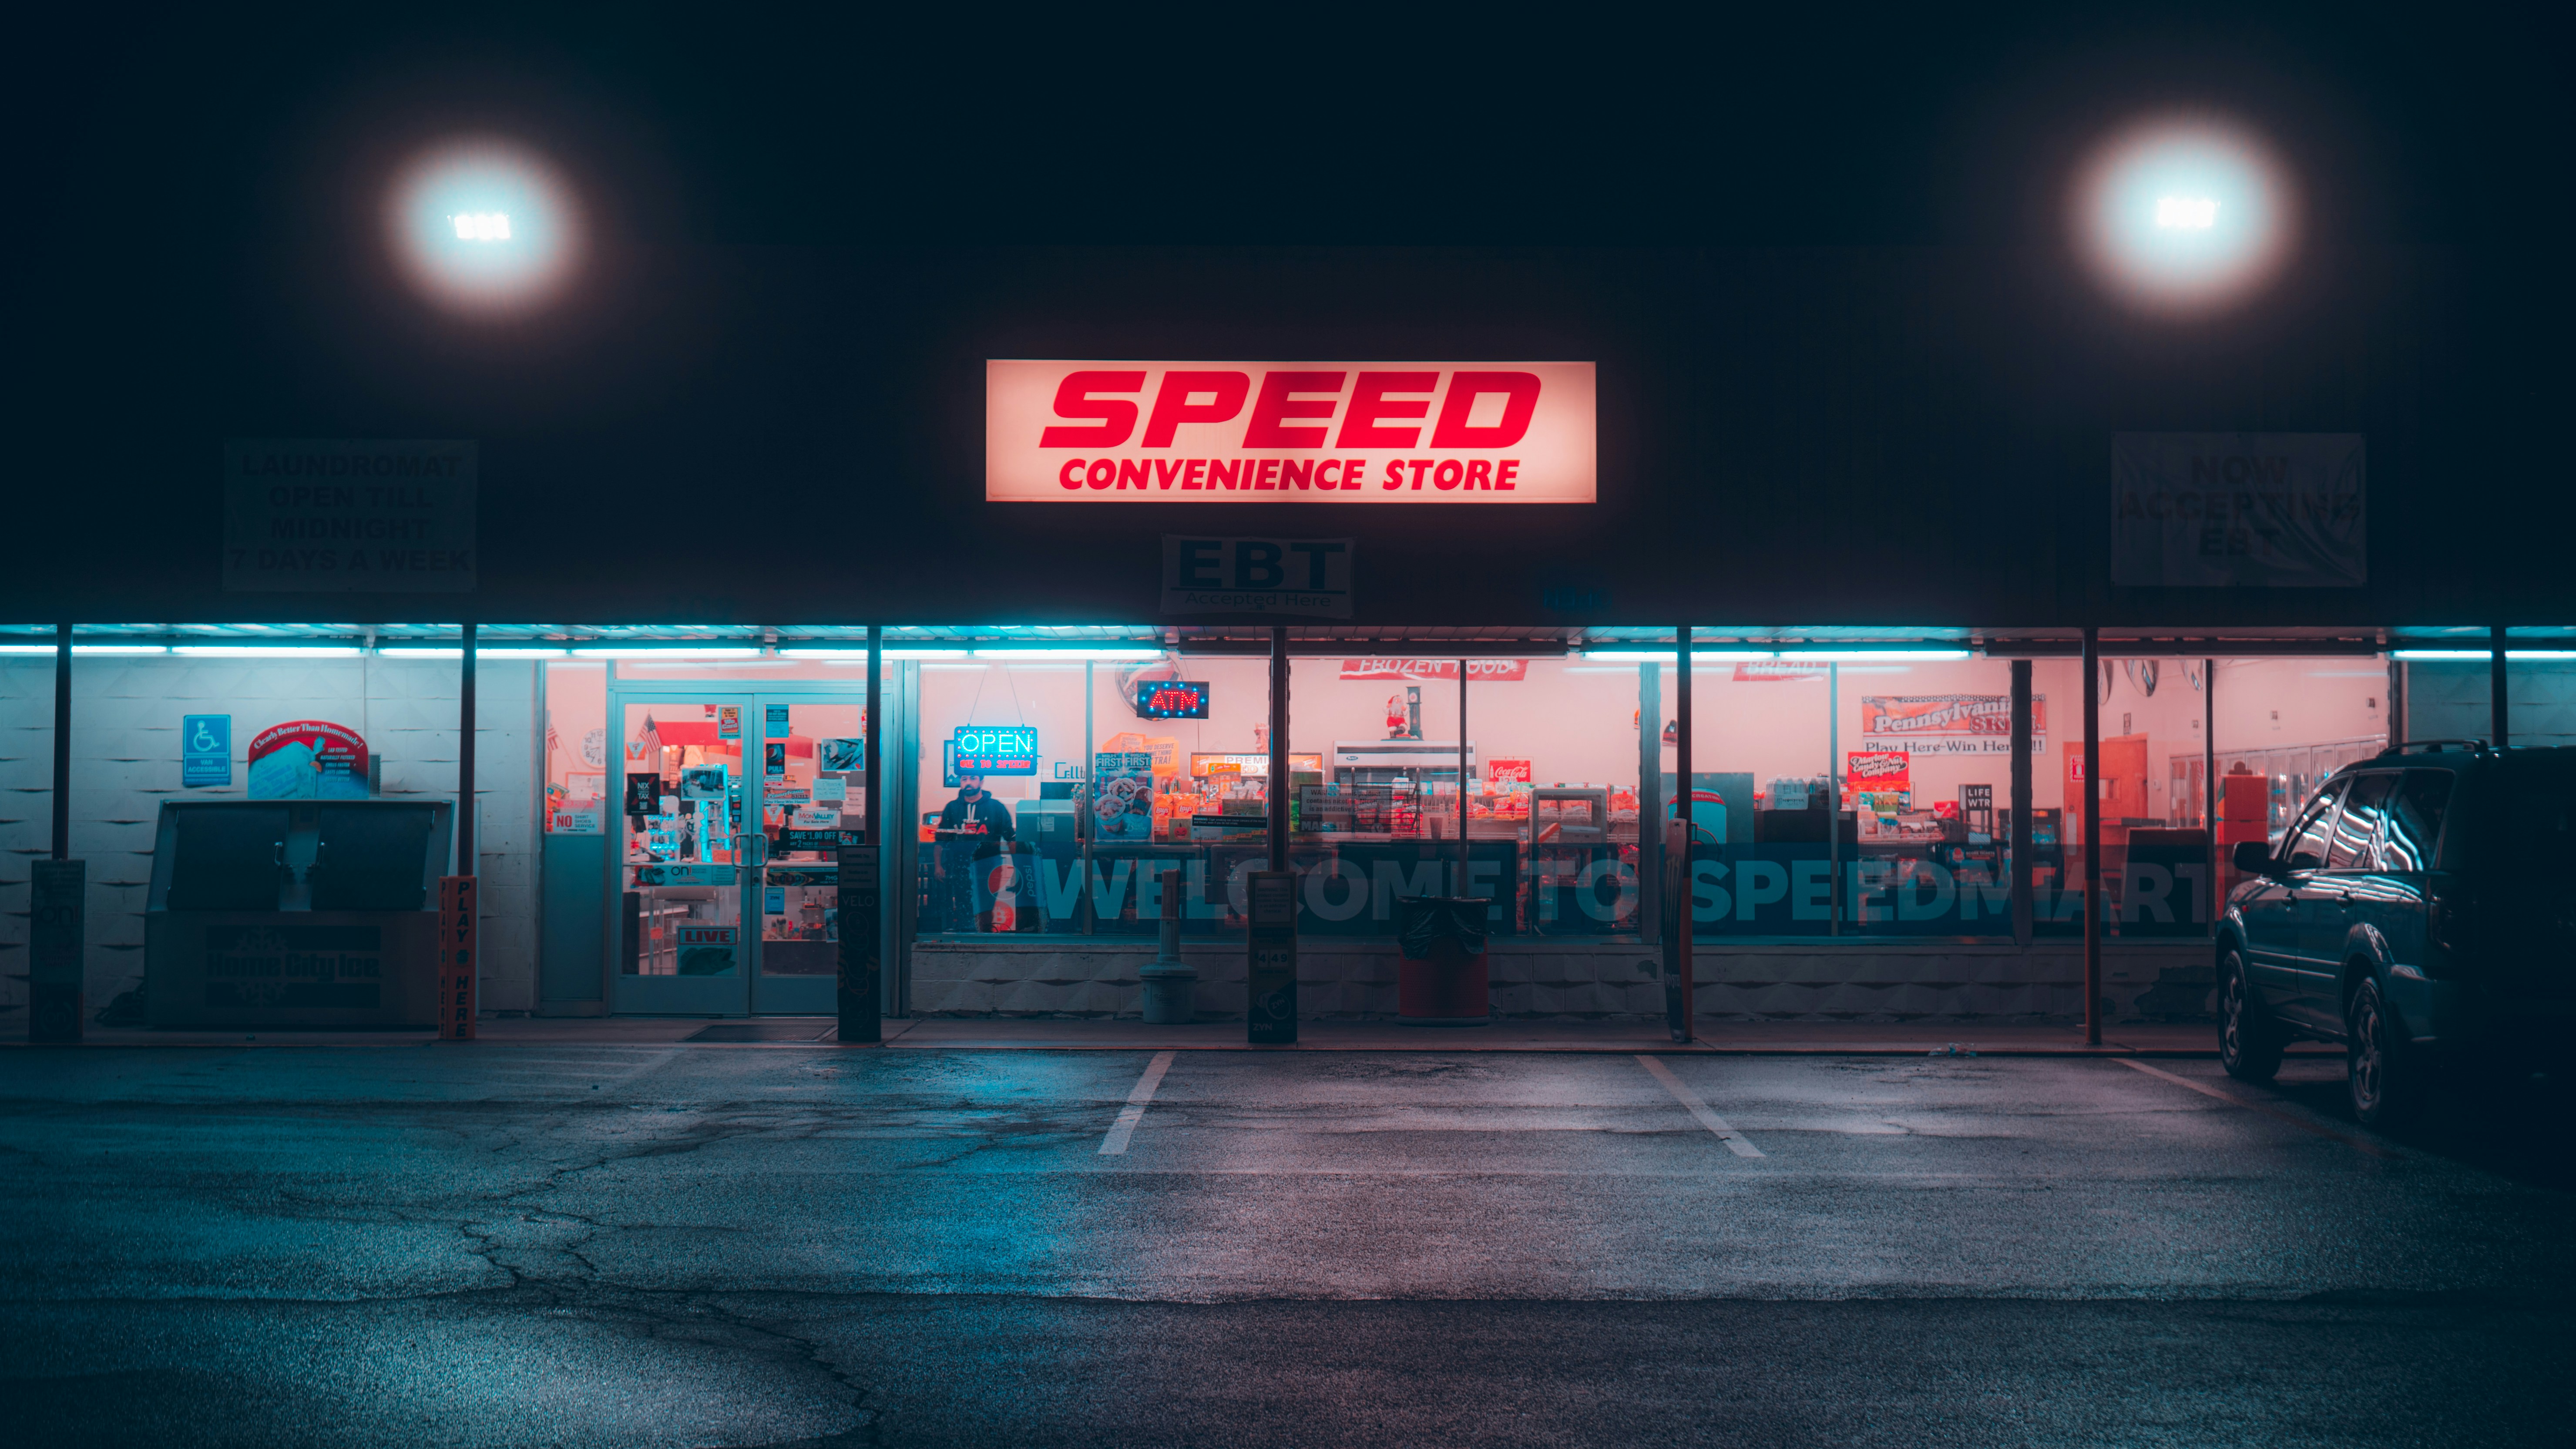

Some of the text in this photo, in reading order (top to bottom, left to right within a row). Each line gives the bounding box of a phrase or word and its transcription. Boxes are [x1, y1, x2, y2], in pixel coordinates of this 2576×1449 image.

[1039, 371, 1542, 449] SPEED
[241, 455, 462, 477] LAUNDROMAT
[1059, 458, 1520, 491] CONVENIENCE STORE
[2191, 455, 2289, 484] NOW
[269, 486, 433, 508] OPEN TILL
[2118, 491, 2360, 520] ACCEPTING
[271, 518, 431, 538] MIDNIGHT
[2198, 528, 2281, 556] EBT
[229, 549, 471, 571] 7 DAYS A WEEK
[1179, 540, 1346, 589] EBT
[1185, 592, 1331, 606] Accepted Here
[1747, 661, 1816, 674] BREAD
[1150, 690, 1198, 710] ATM
[254, 731, 278, 749] Clearly
[277, 726, 301, 736] Better
[301, 723, 320, 732] Than
[961, 734, 1030, 752] OPEN
[1097, 757, 1122, 766] FIRST
[1125, 757, 1151, 766] FIRST
[1968, 788, 1990, 797] LIFE
[1968, 799, 1990, 807] WTR
[556, 815, 572, 827] NO
[954, 823, 988, 835] USA
[807, 831, 823, 840] $1.00
[671, 866, 692, 876] on!
[1023, 865, 1036, 897] pepsi
[1521, 858, 1640, 922] TO
[841, 895, 874, 906] VELO
[39, 905, 79, 924] on!
[457, 882, 470, 942] PLAY
[685, 931, 730, 942] LIVE
[206, 952, 380, 982] Home City Ice
[455, 976, 469, 1037] HERE
[1271, 997, 1286, 1010] ZYN
